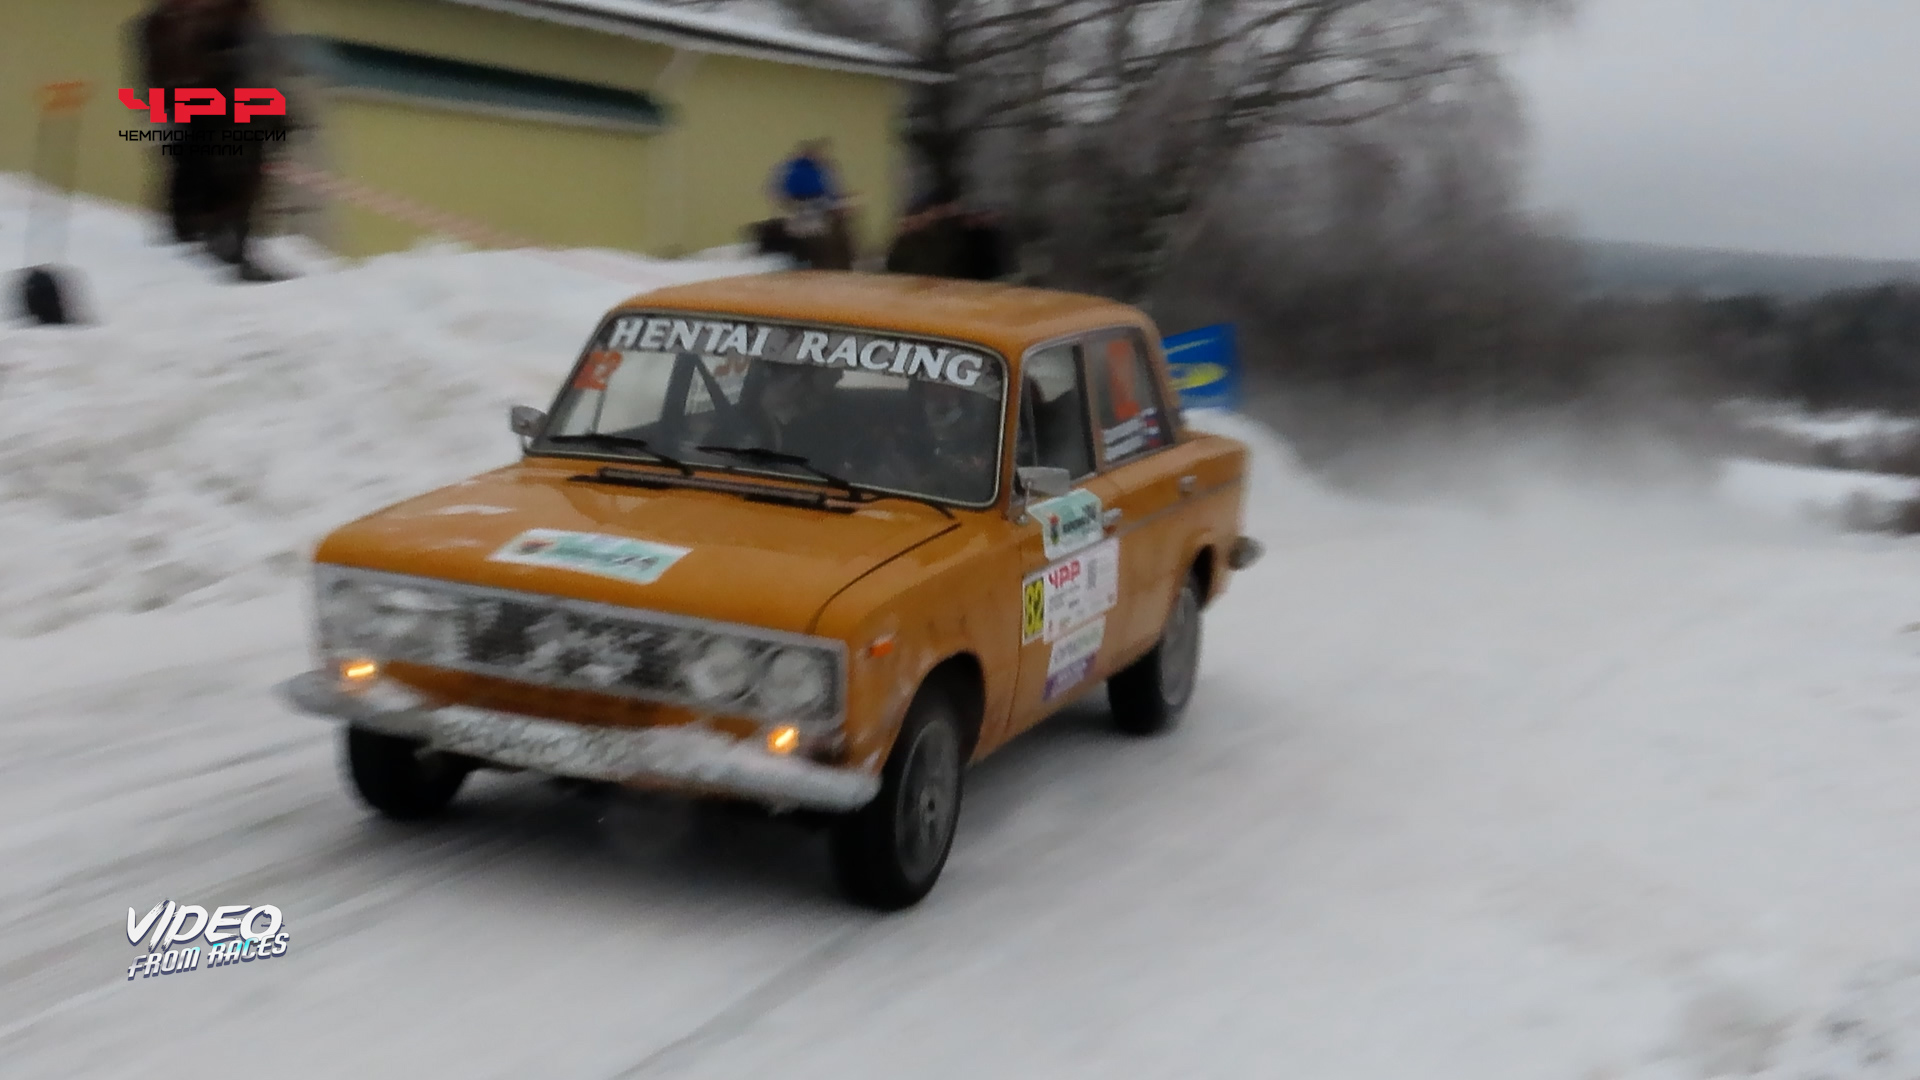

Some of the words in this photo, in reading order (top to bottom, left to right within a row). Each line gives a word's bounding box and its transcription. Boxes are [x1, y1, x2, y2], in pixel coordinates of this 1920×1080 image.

[607, 317, 771, 357] HENTAI
[796, 330, 983, 387] RACING
[1048, 560, 1081, 589] ЧРР
